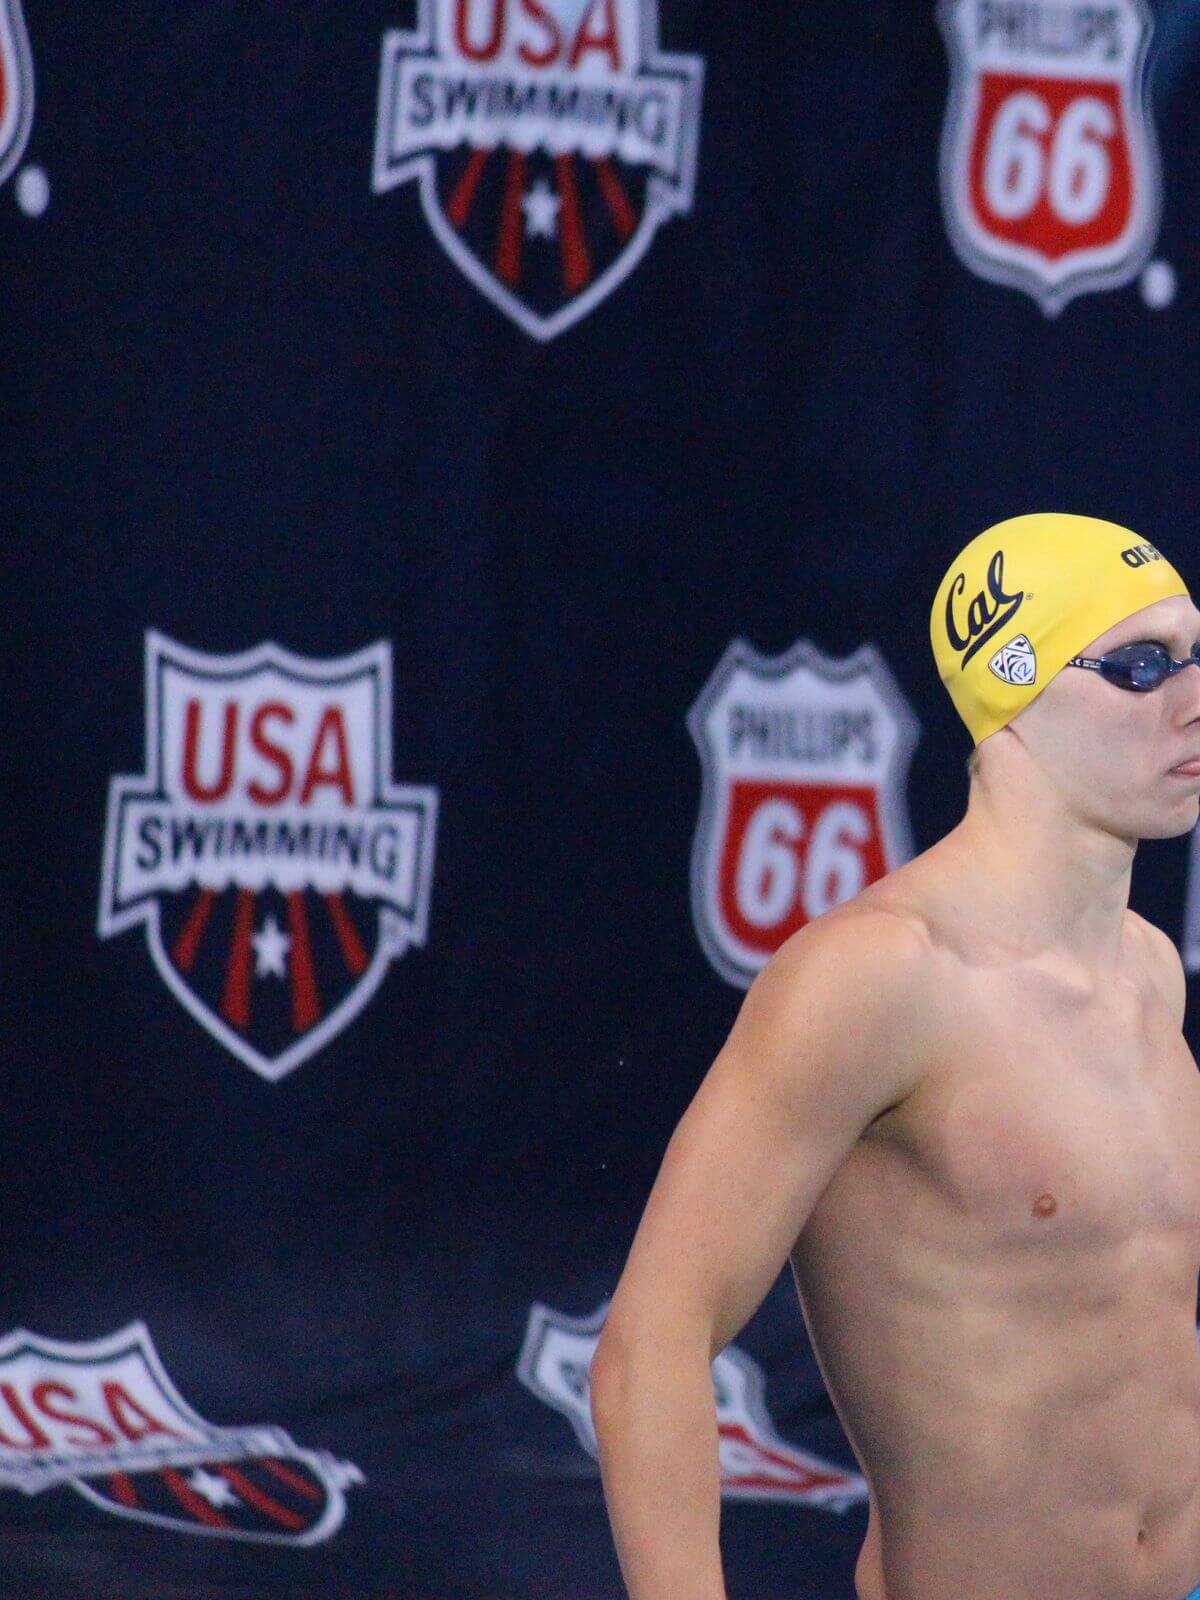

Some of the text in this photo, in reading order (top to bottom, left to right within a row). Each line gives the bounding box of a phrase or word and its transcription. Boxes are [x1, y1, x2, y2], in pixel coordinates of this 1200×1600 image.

[452, 0, 623, 72] USA
[409, 74, 668, 144] SWIMMING
[983, 90, 1115, 225] 66
[945, 550, 1023, 668] Cal
[182, 697, 357, 806] USA
[135, 816, 401, 880] SWIMMING
[736, 798, 872, 927] 66
